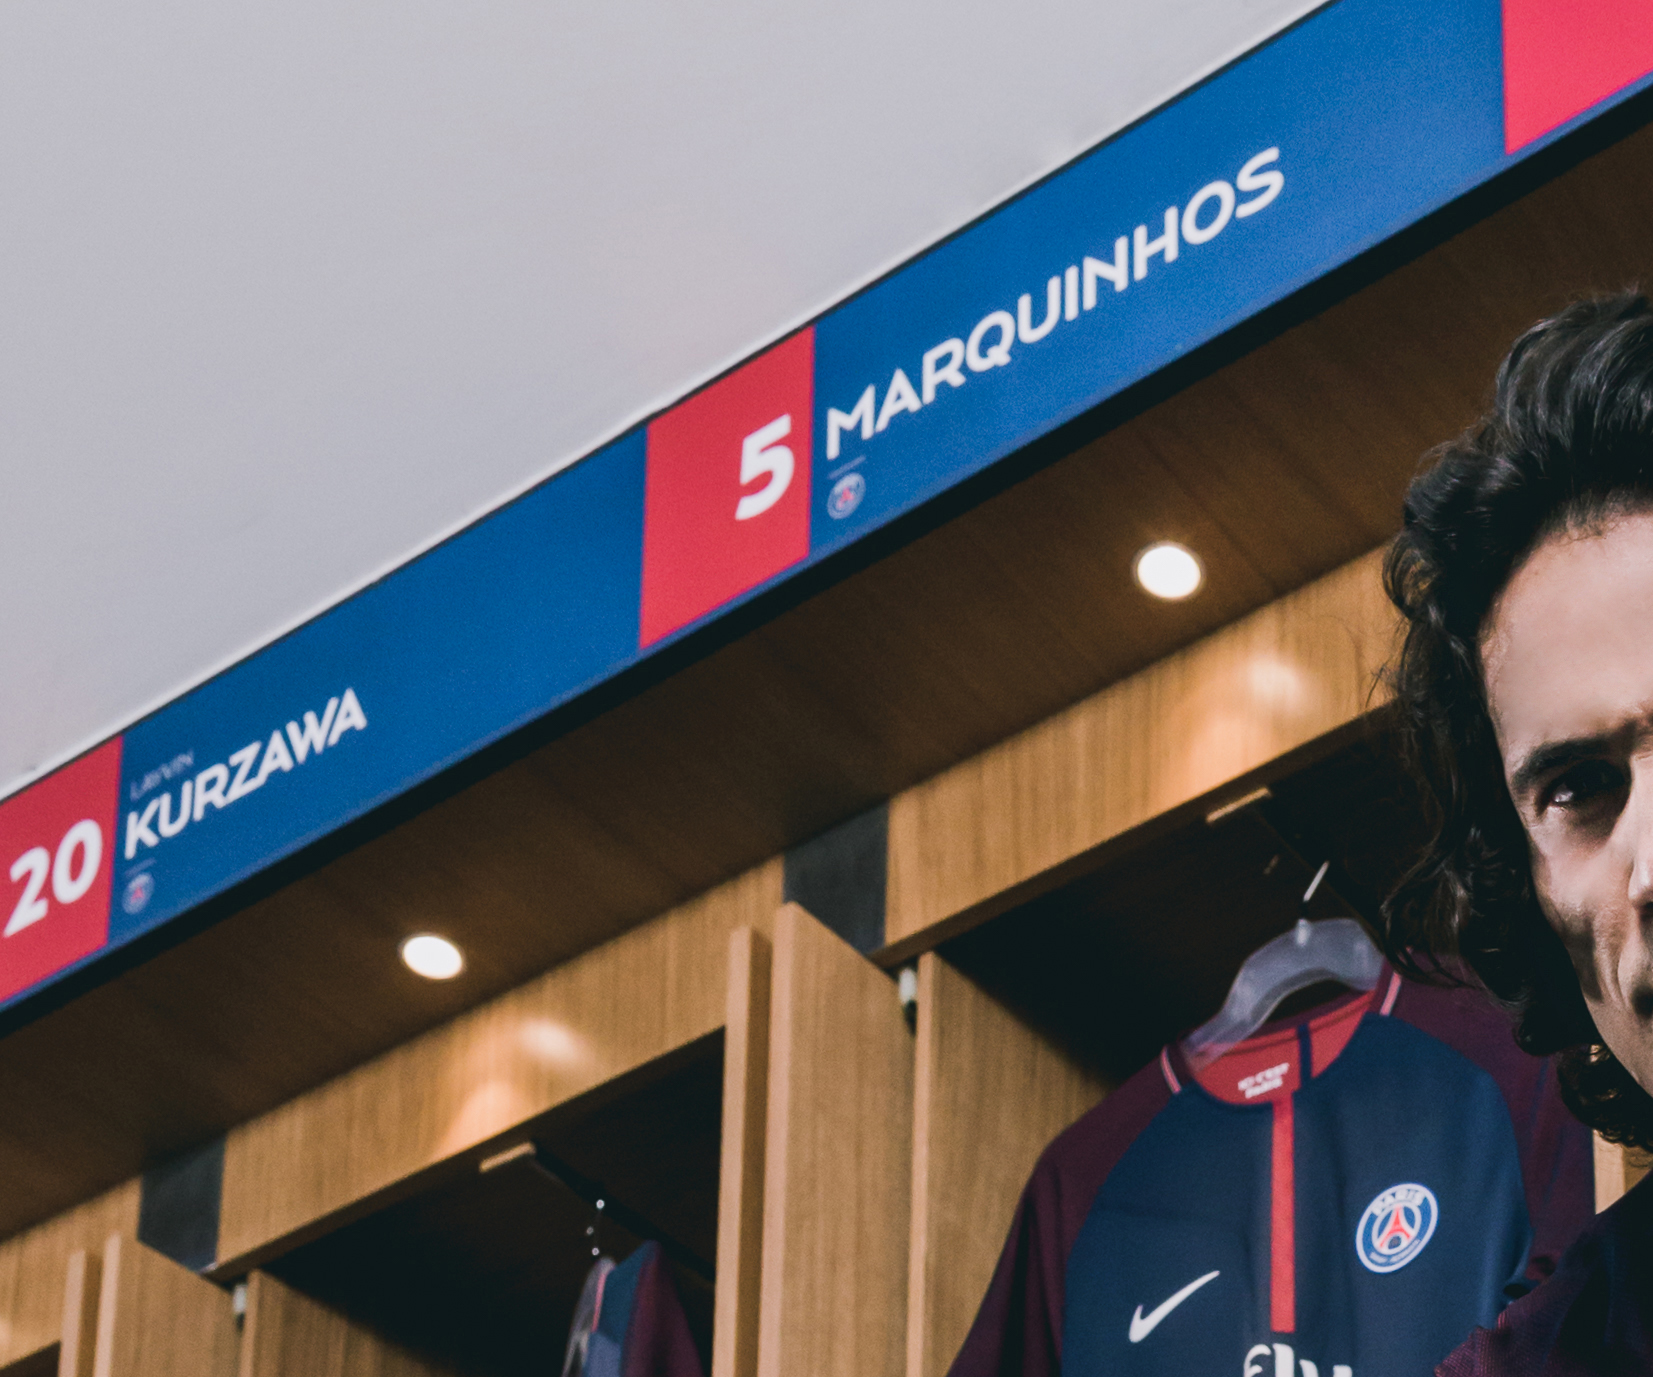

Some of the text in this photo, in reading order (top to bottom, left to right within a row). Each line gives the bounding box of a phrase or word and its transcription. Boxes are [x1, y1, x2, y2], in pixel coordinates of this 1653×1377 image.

[826, 146, 1285, 461] MARQUINHOS
[735, 414, 795, 521] 5
[124, 687, 367, 860] KURZAWA
[3, 818, 103, 938] 20
[1371, 1188, 1427, 1217] PARIS
